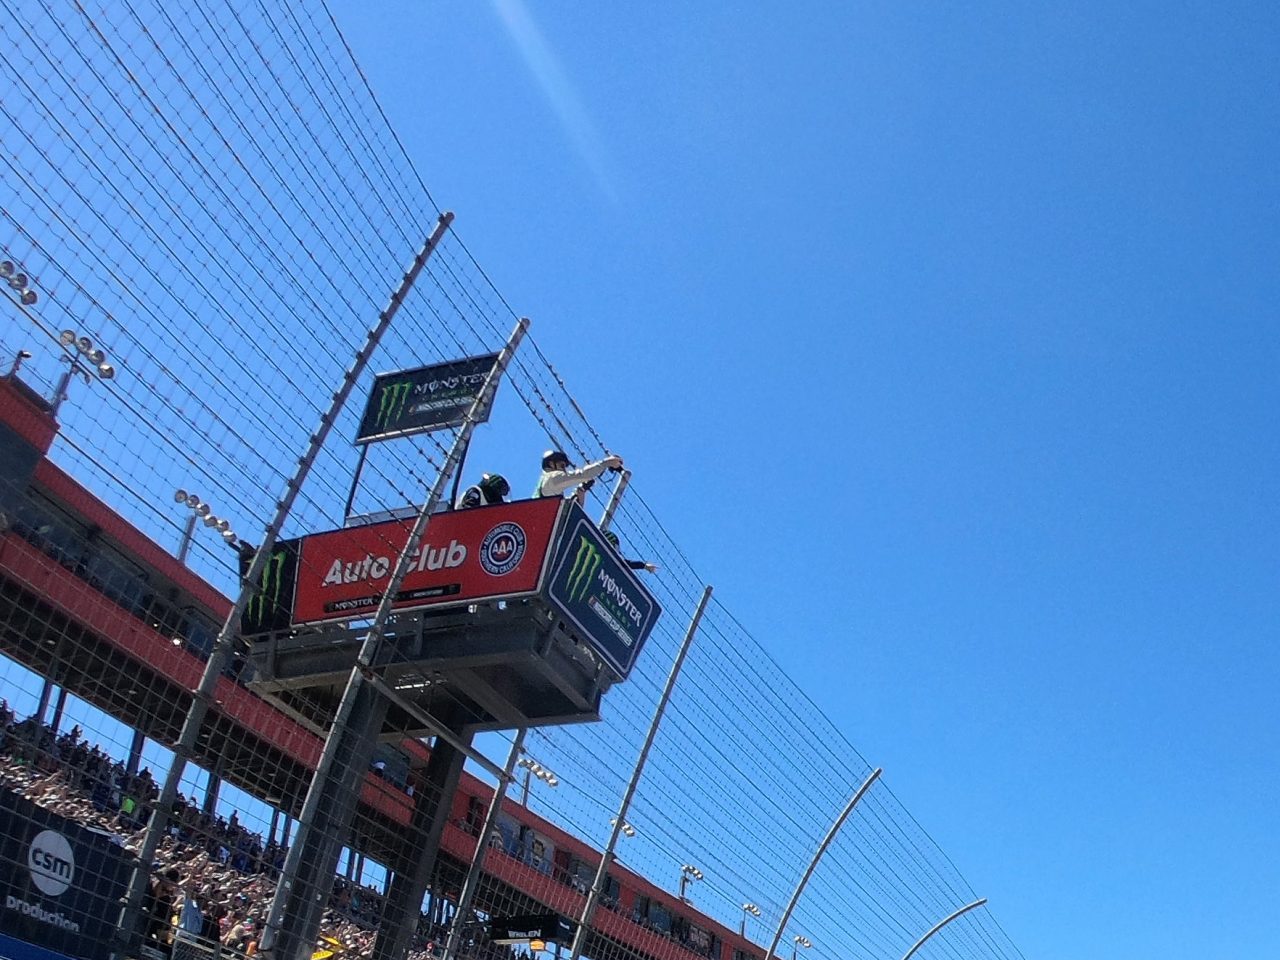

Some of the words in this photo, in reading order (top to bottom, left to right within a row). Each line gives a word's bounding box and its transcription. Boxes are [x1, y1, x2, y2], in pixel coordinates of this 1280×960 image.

[491, 540, 513, 555] AAA
[321, 558, 390, 586] Auto
[597, 568, 642, 628] MONSTER
[32, 848, 71, 879] csm
